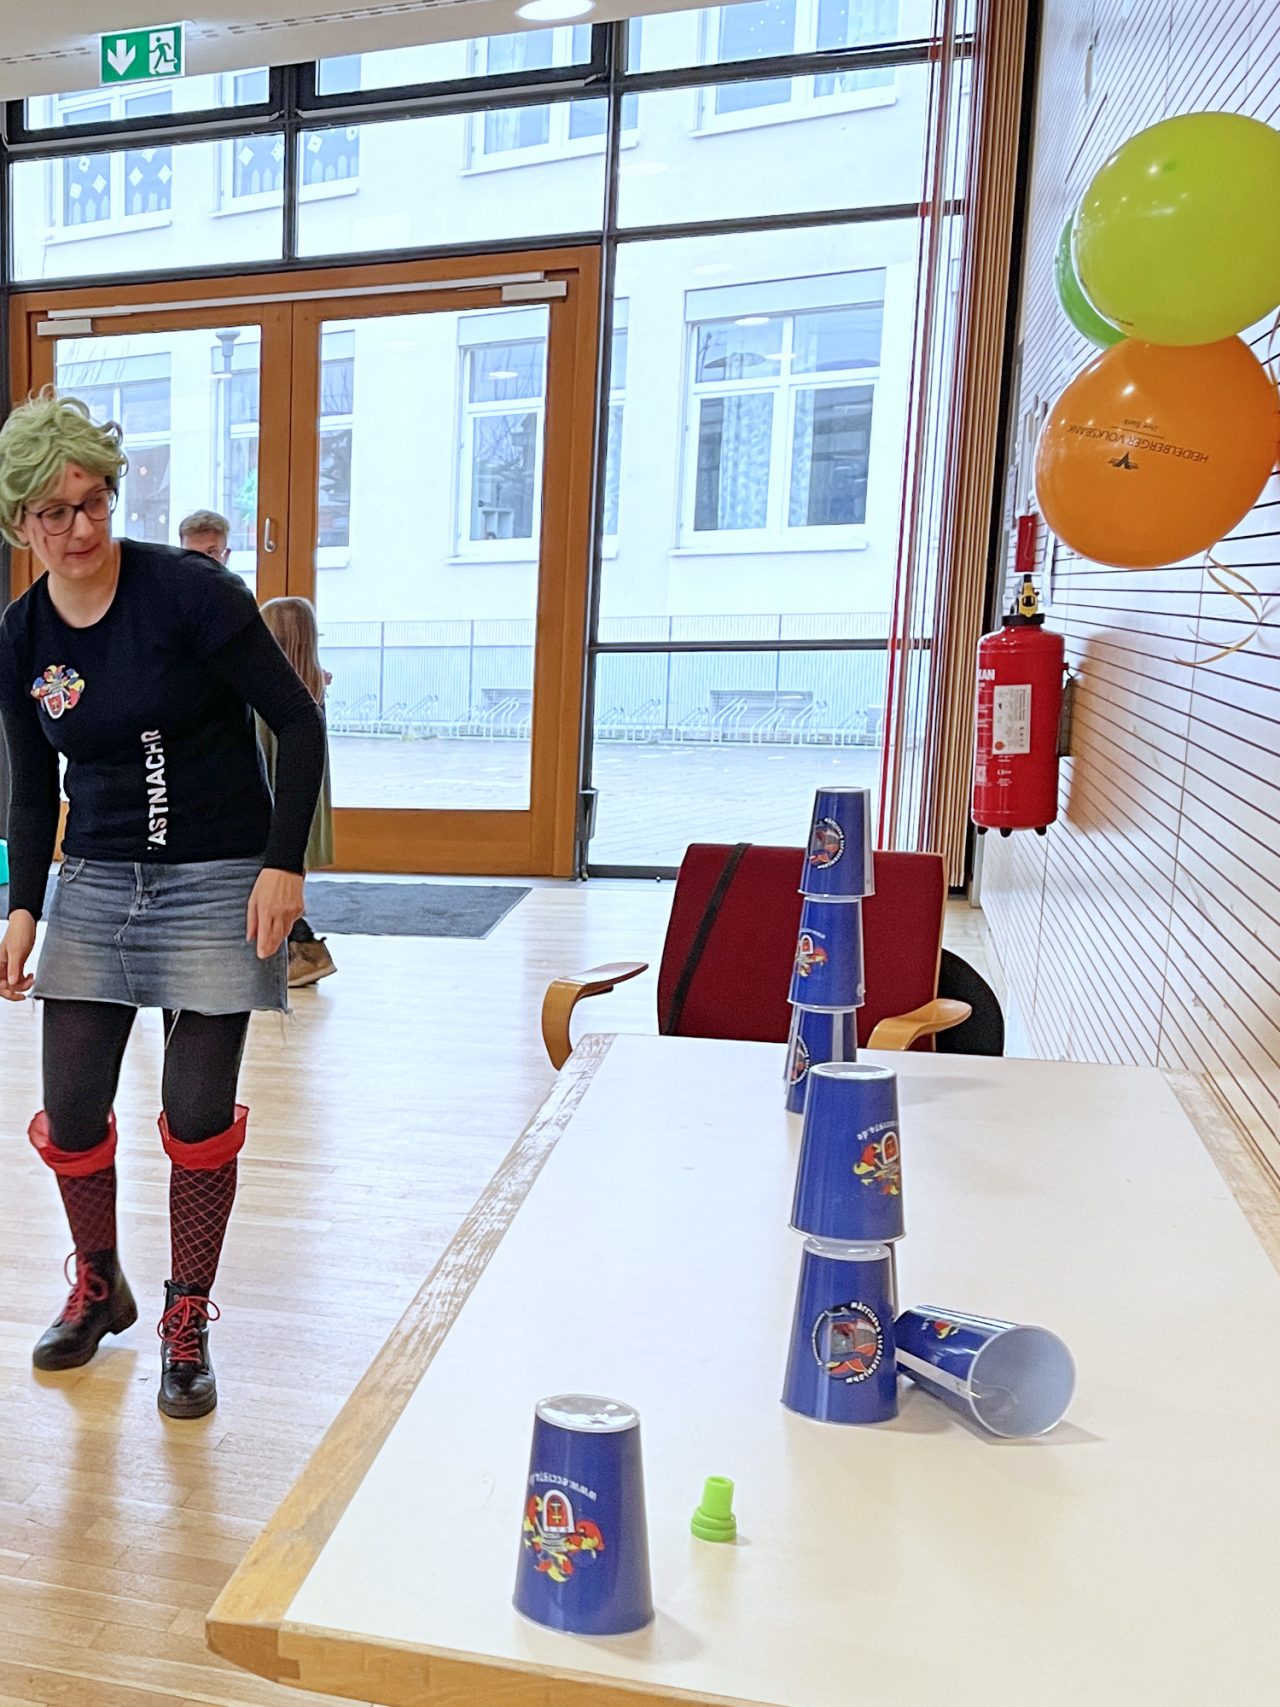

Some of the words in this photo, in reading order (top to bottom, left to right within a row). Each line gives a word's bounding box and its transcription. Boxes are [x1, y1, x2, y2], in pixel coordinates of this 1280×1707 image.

[1067, 424, 1125, 443] VOLKSBANK
[1127, 435, 1209, 463] HEIDELBERGER
[141, 729, 169, 850] ASTNACHR
